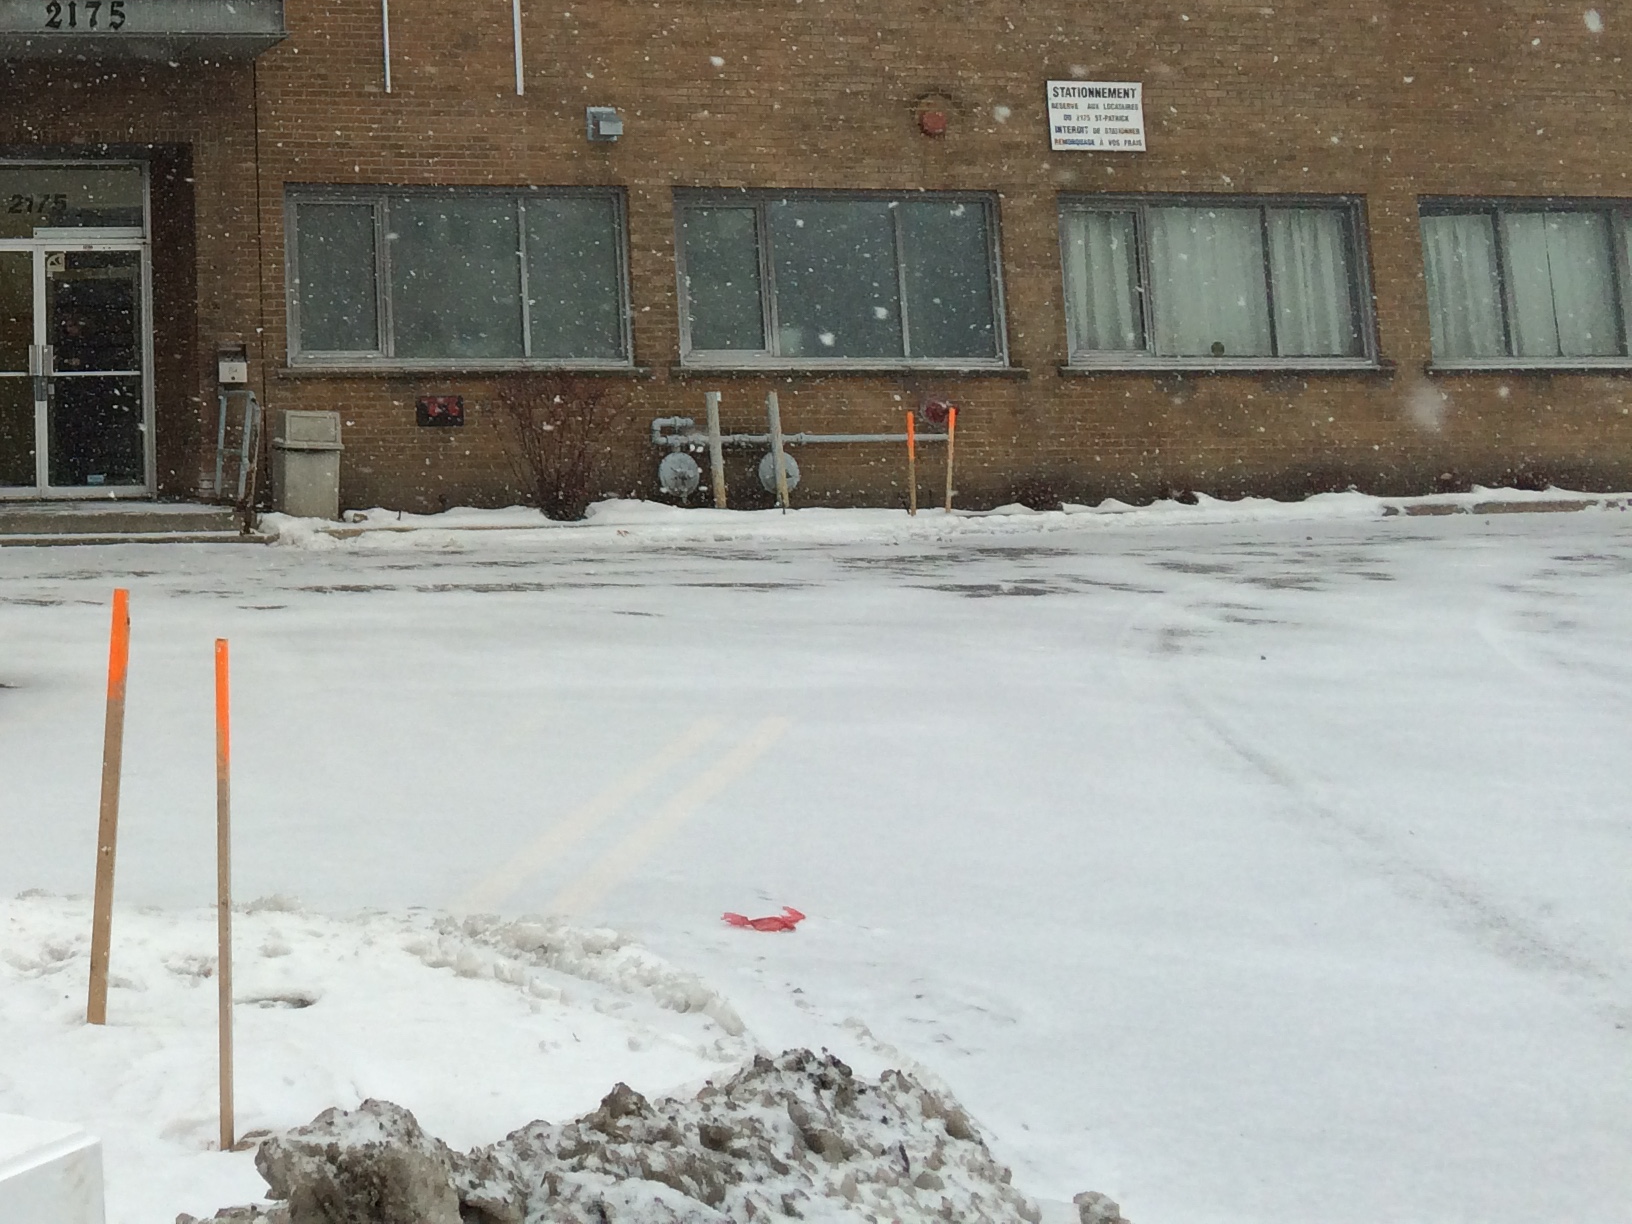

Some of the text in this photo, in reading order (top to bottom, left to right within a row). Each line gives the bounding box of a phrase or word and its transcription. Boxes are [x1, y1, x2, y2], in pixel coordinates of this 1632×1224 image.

[45, 0, 126, 30] 2175
[1052, 86, 1136, 99] STATIONNEMENT
[8, 193, 67, 214] 2175
